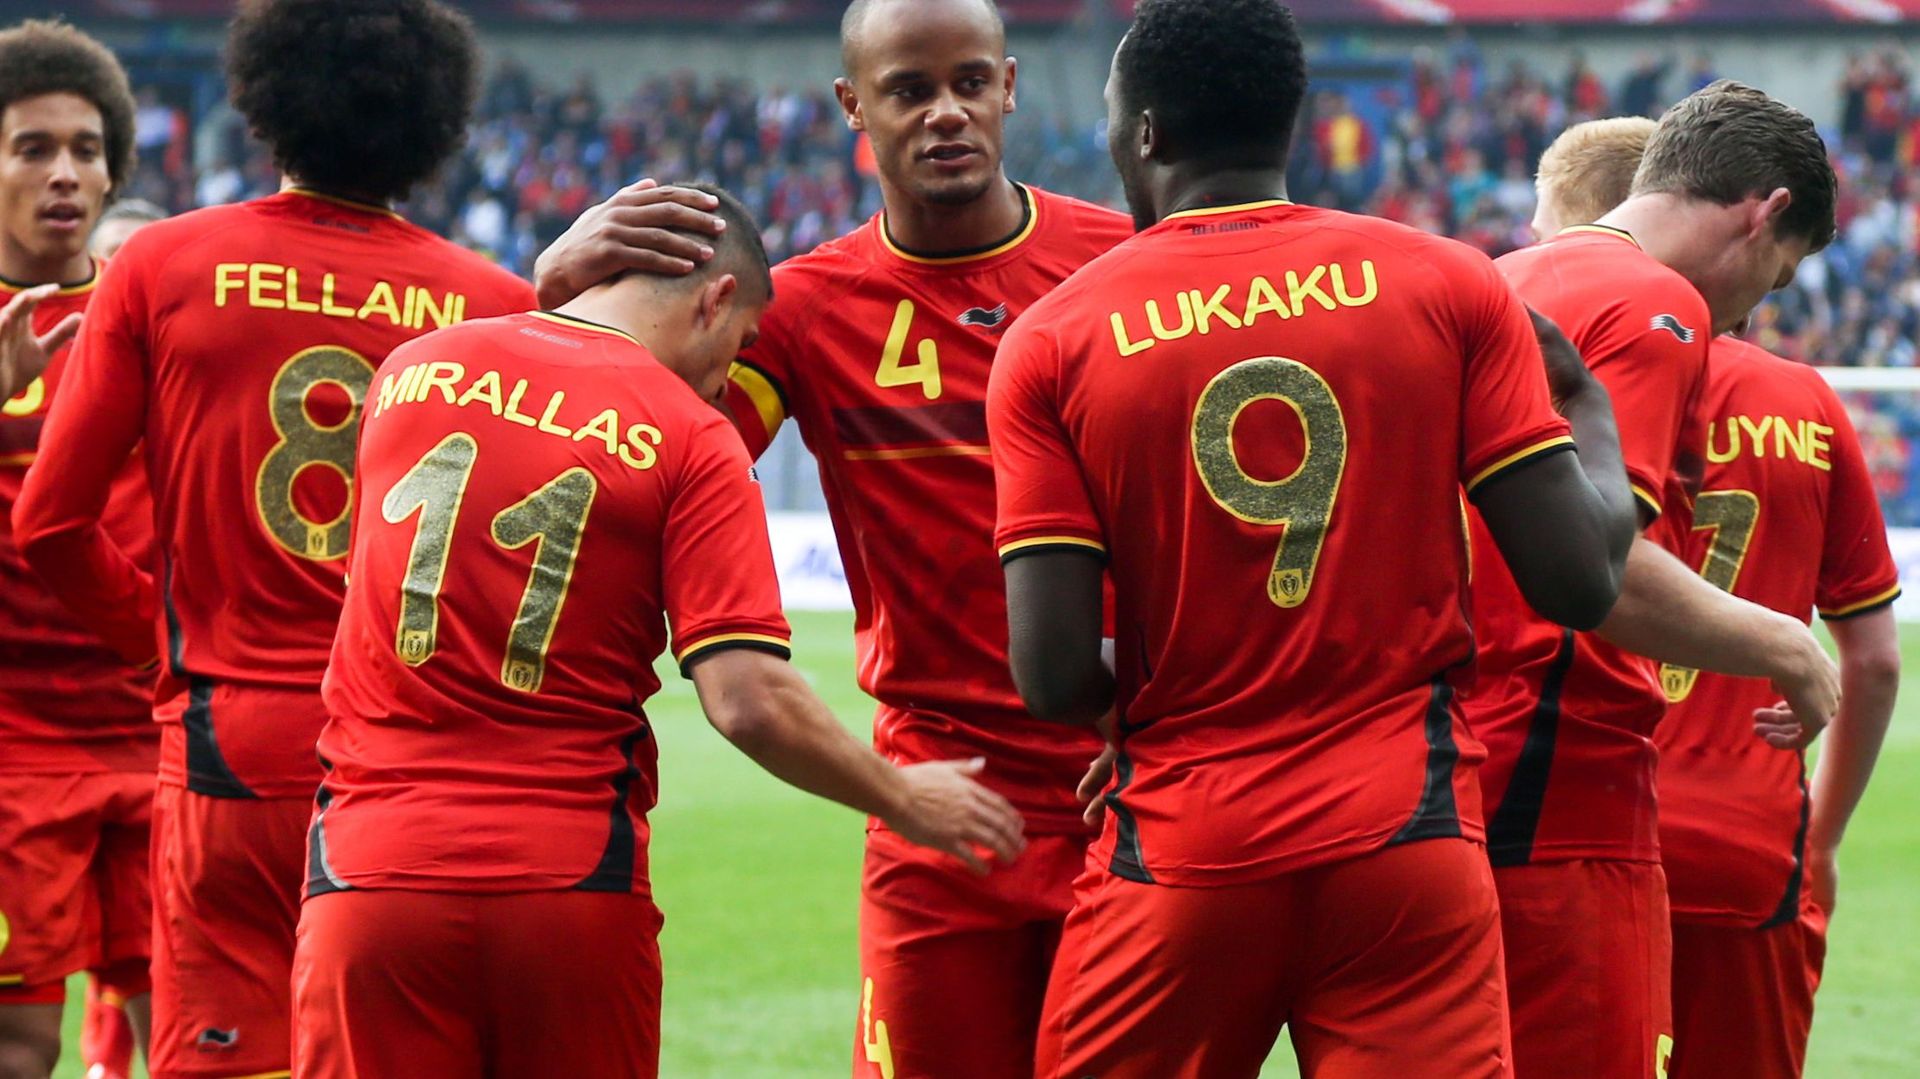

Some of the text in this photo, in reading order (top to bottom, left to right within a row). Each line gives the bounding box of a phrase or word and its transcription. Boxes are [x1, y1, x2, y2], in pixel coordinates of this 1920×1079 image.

[214, 262, 467, 331] FELLAINI
[1110, 260, 1379, 357] LUKAKU
[875, 299, 942, 400] 4
[255, 344, 376, 562] 8
[373, 361, 663, 471] MIRALLAS
[1706, 415, 1835, 472] UYNE
[1190, 355, 1348, 609] 9
[381, 431, 599, 694] 11
[862, 976, 896, 1079] 4
